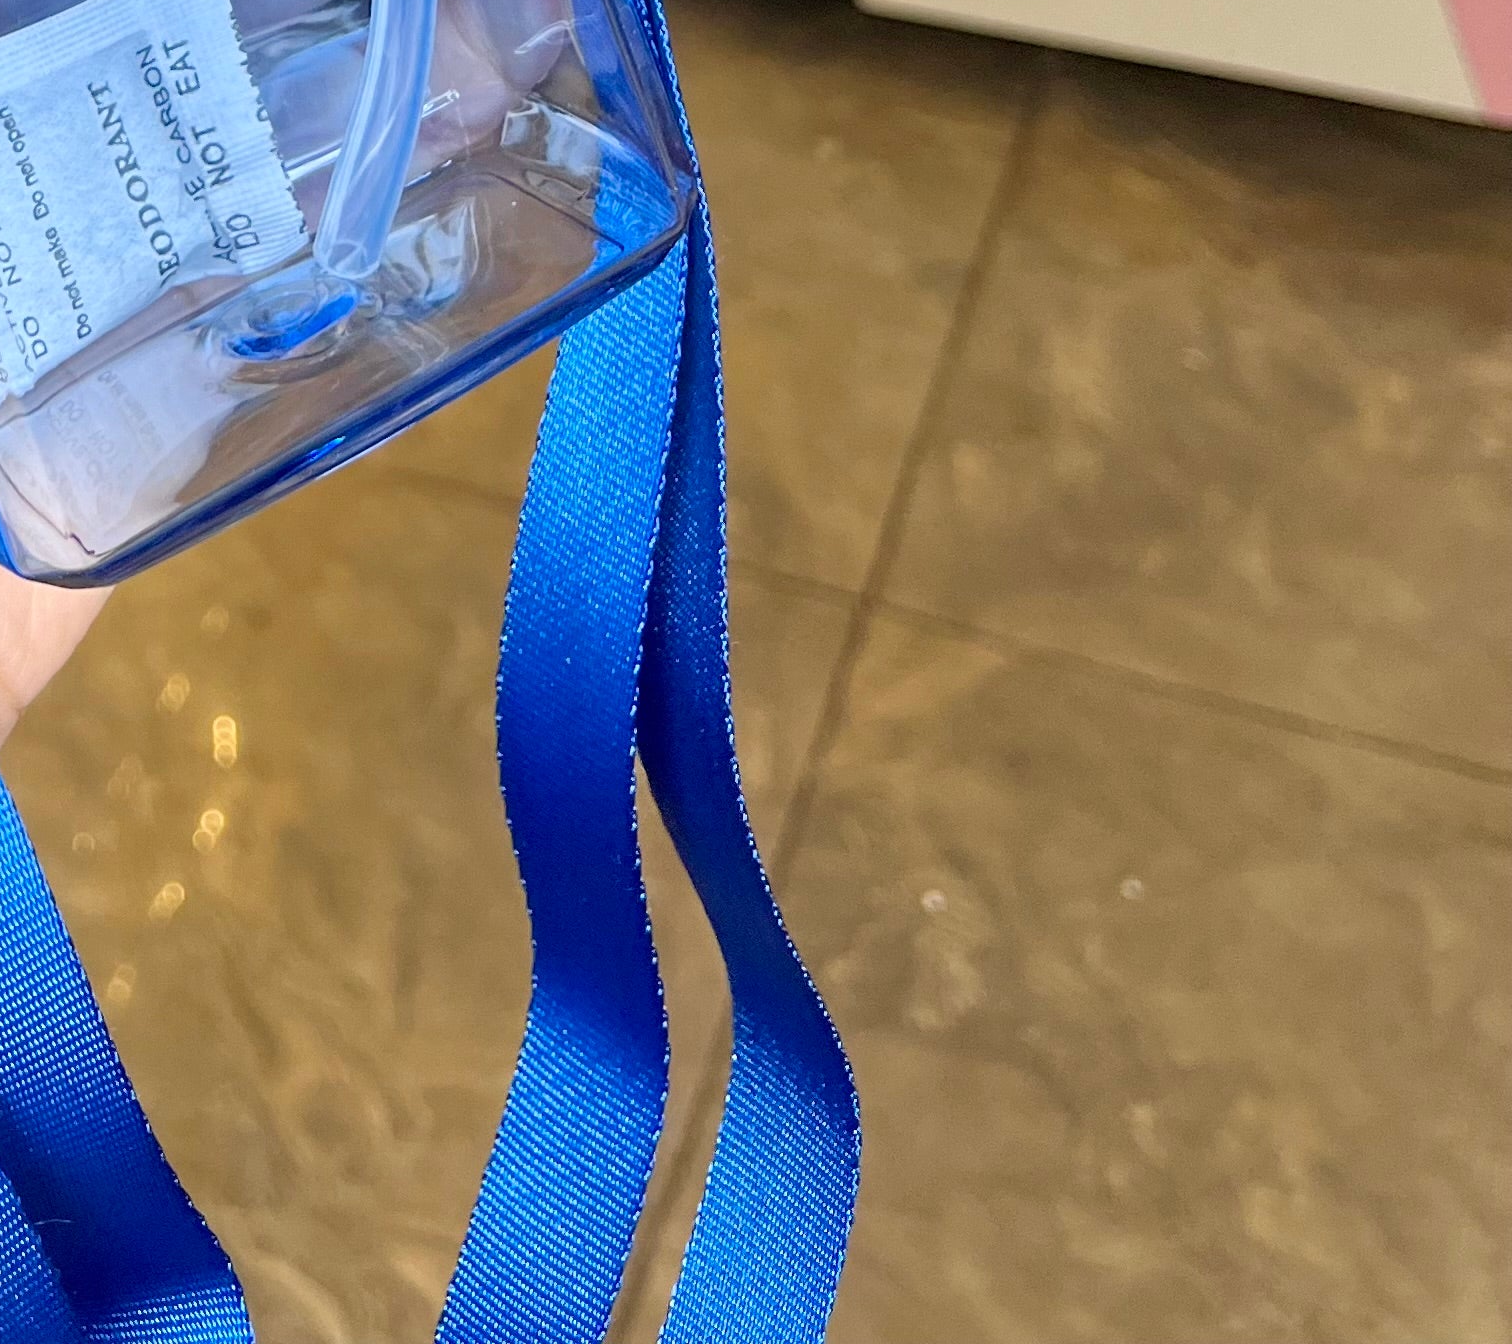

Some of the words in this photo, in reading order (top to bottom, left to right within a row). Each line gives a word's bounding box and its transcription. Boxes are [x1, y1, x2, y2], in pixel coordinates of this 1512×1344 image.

[161, 37, 201, 97] EAT
[135, 43, 193, 165] CARBON
[15, 155, 39, 187] not
[189, 123, 236, 189] NOT
[31, 190, 51, 221] Do
[44, 226, 74, 279] make
[225, 212, 261, 252] DO
[62, 279, 85, 311] not
[22, 315, 49, 360] DO
[75, 312, 93, 340] Do
